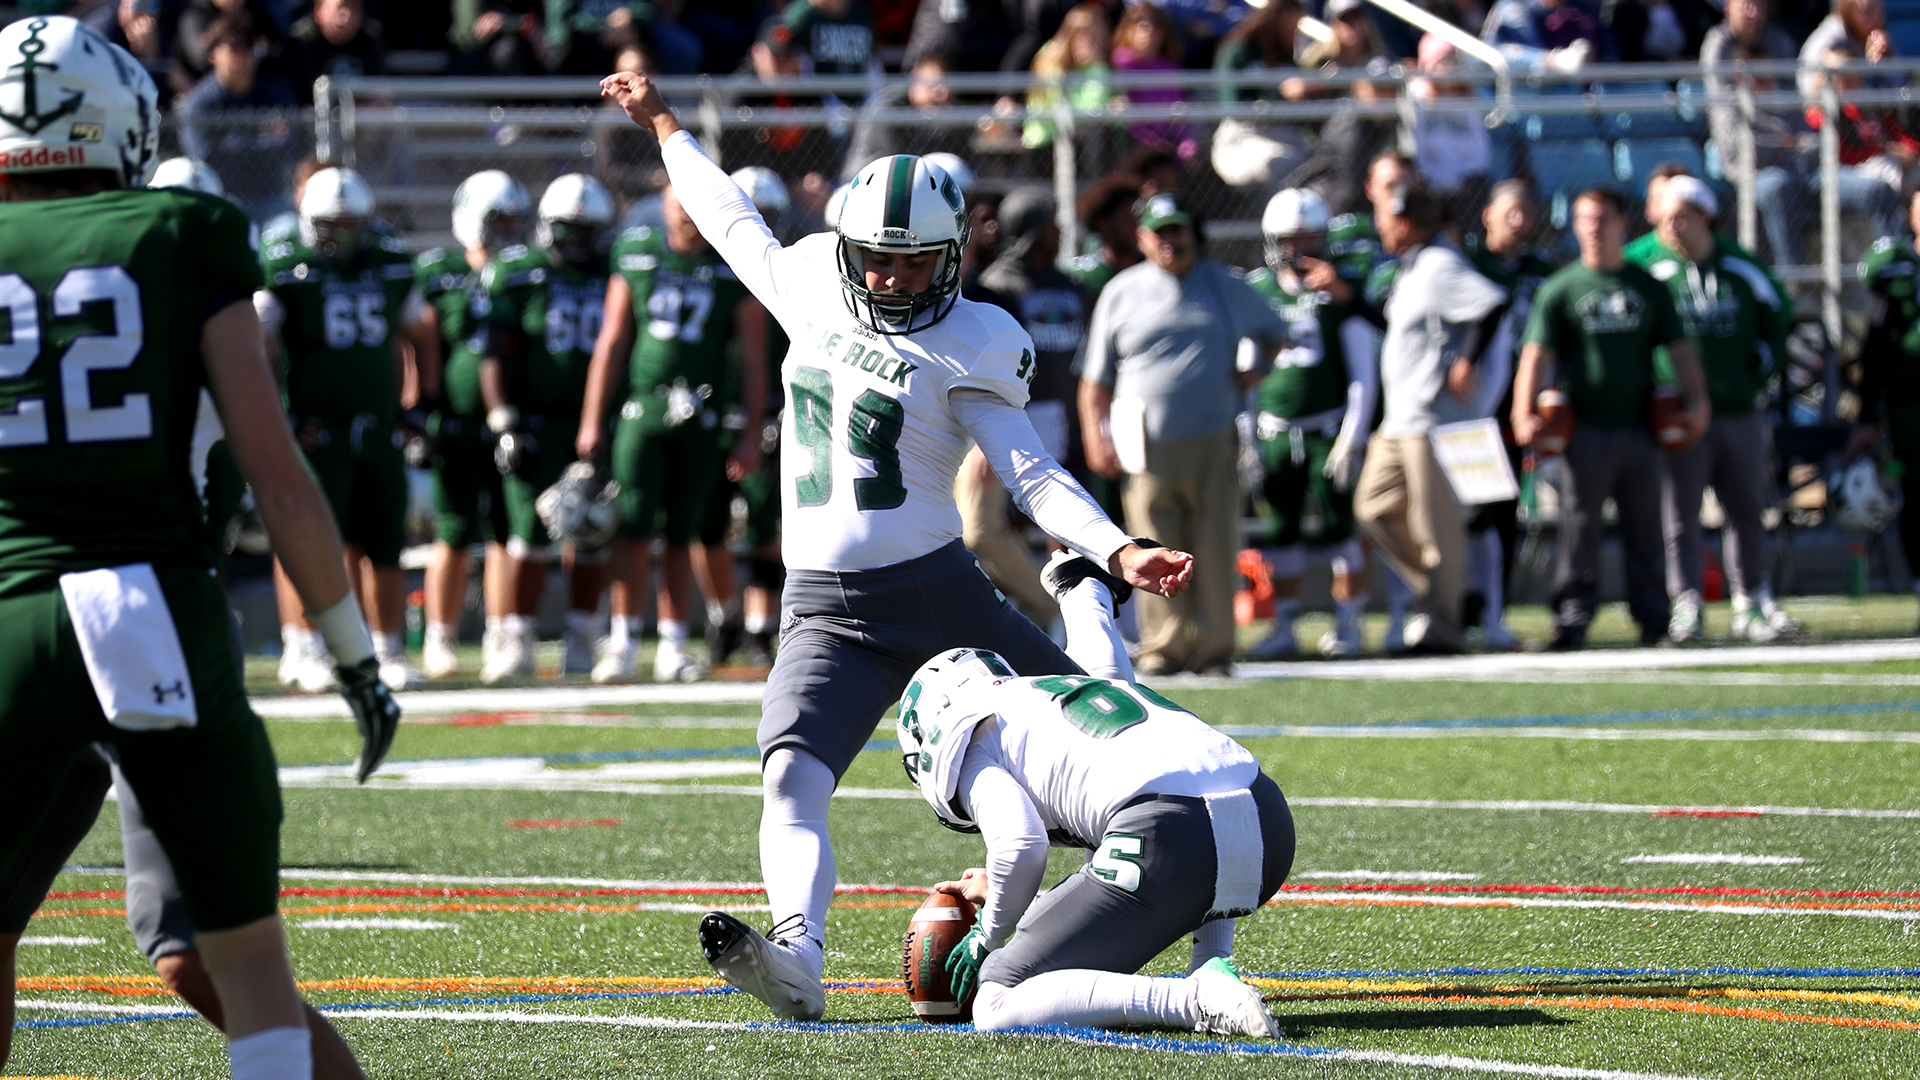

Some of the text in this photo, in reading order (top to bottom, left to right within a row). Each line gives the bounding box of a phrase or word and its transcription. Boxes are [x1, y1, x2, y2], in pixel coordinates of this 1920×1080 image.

[0, 145, 85, 169] Riddell
[883, 229, 907, 239] ROCK
[323, 293, 388, 349] 65
[647, 287, 715, 343] 97
[851, 326, 879, 342] adidas
[0, 265, 153, 446] 22
[842, 341, 919, 388] ROCK
[790, 365, 909, 512] 99
[918, 932, 933, 989] Wilson
